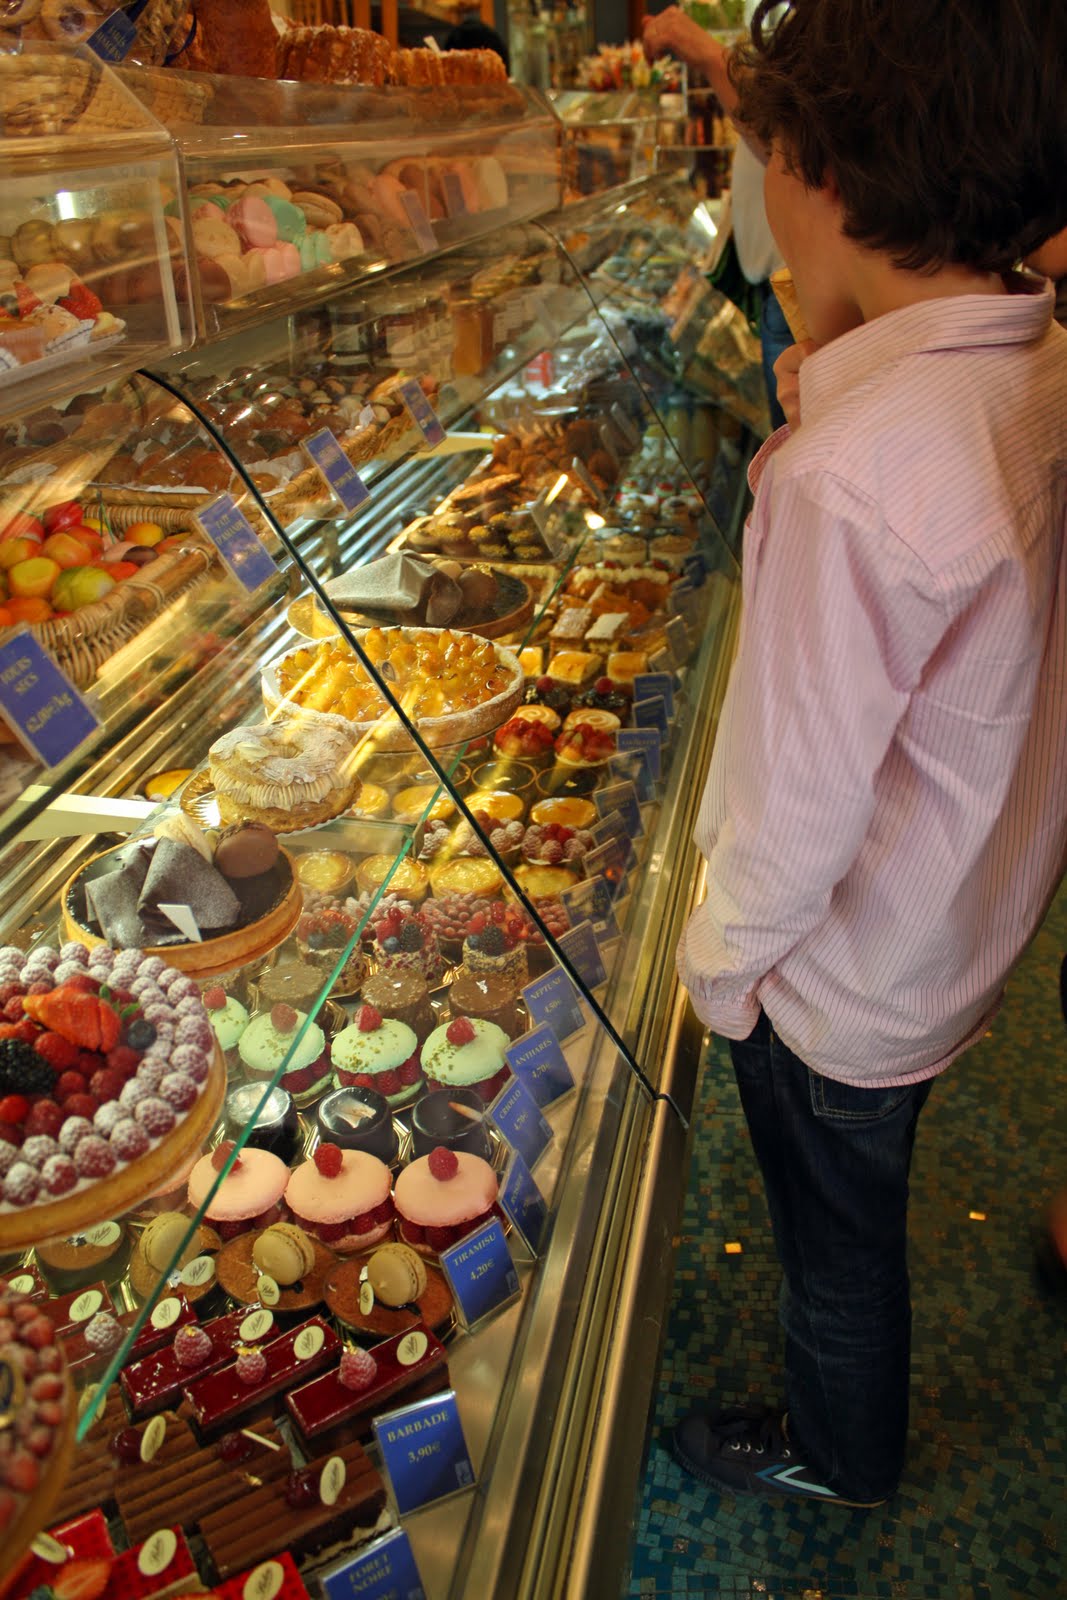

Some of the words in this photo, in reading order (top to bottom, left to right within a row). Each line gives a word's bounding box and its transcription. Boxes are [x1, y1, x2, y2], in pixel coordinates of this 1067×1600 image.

[530, 975, 563, 1000] NEPTUNE
[514, 1039, 553, 1067] ANTHARES
[499, 1089, 521, 1119] CRIOLLO
[453, 1232, 497, 1266] TIRAMISU
[470, 1259, 496, 1281] 4,20€
[387, 1410, 449, 1442] BARBADE
[408, 1441, 440, 1463] 3,90€
